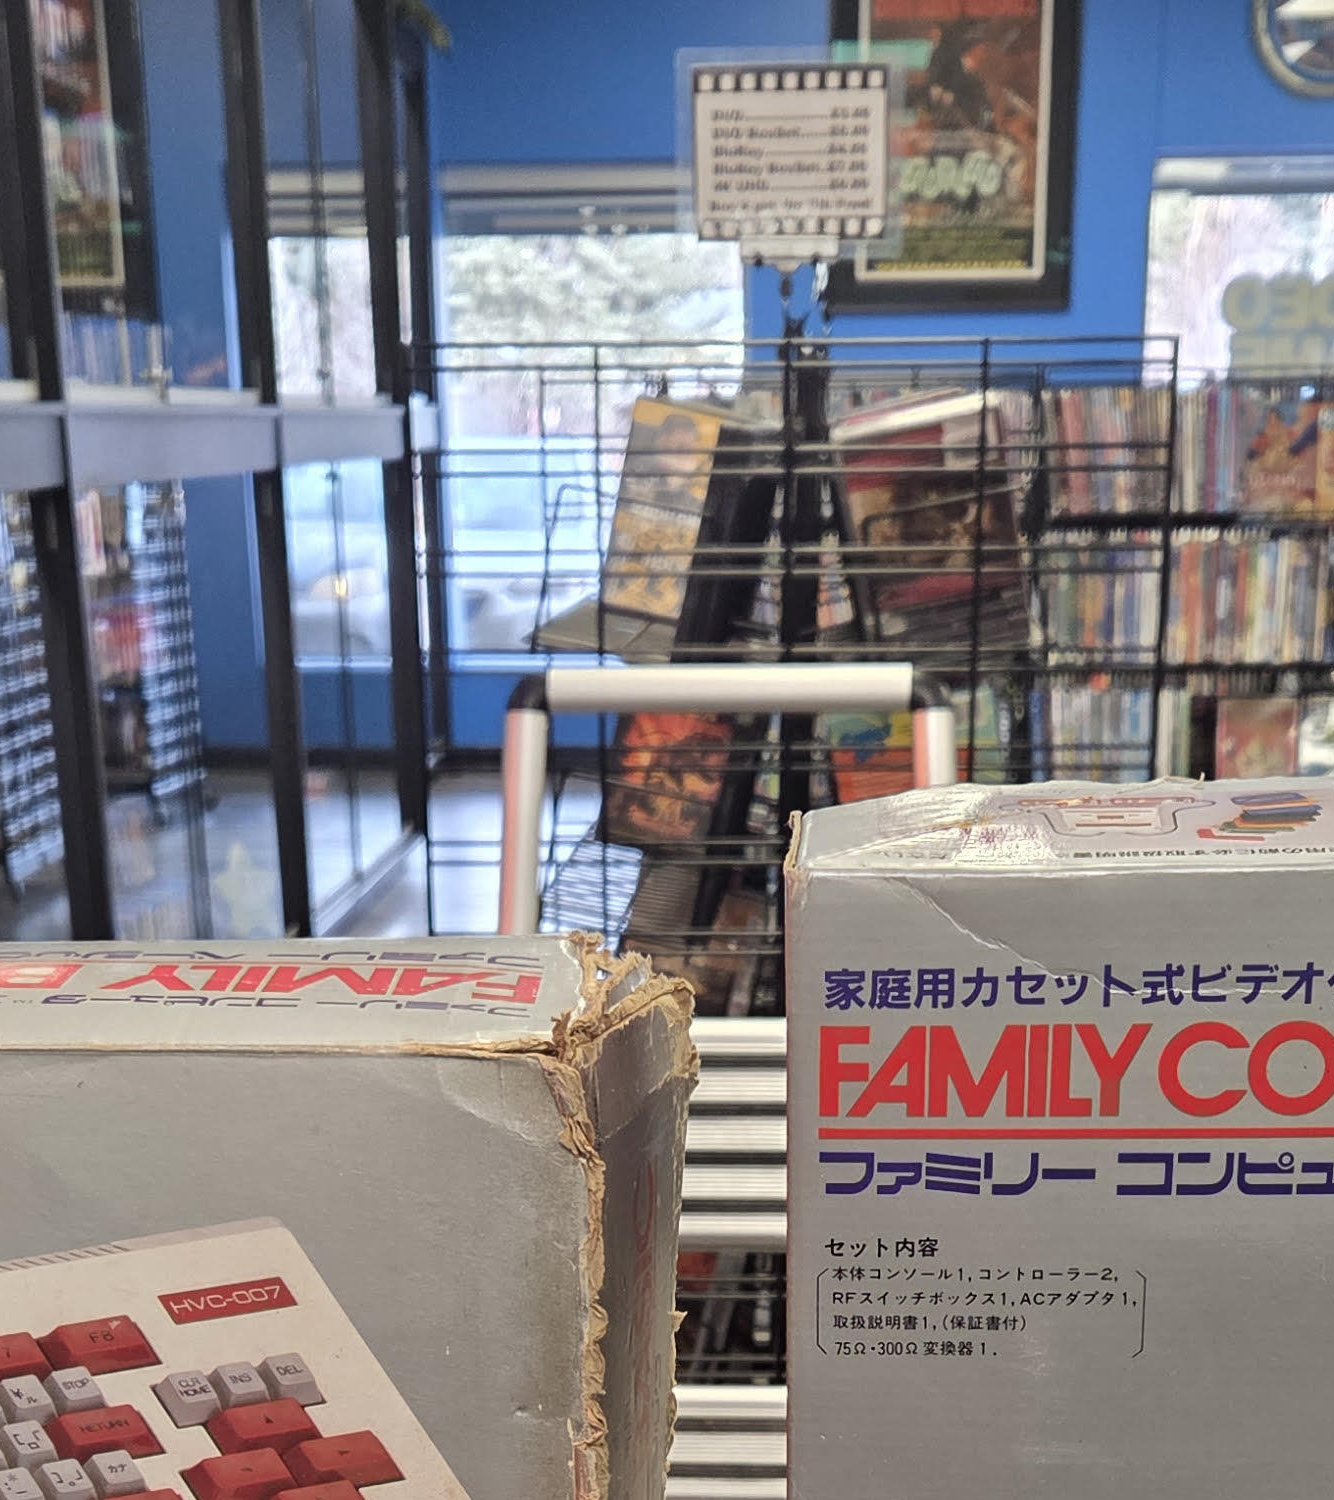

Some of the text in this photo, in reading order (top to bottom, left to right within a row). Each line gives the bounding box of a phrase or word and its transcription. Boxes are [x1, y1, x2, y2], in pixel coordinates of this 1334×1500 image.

[103, 964, 545, 1005] FAMILY
[819, 1022, 1153, 1117] FAMILY
[819, 1151, 1096, 1195] ファミリー
[824, 1237, 939, 1258] セット内容
[169, 1286, 282, 1315] HVC-007
[88, 1330, 115, 1344] F8
[229, 1373, 252, 1384] INS
[276, 1365, 304, 1376] DEL
[62, 1377, 89, 1390] STOP
